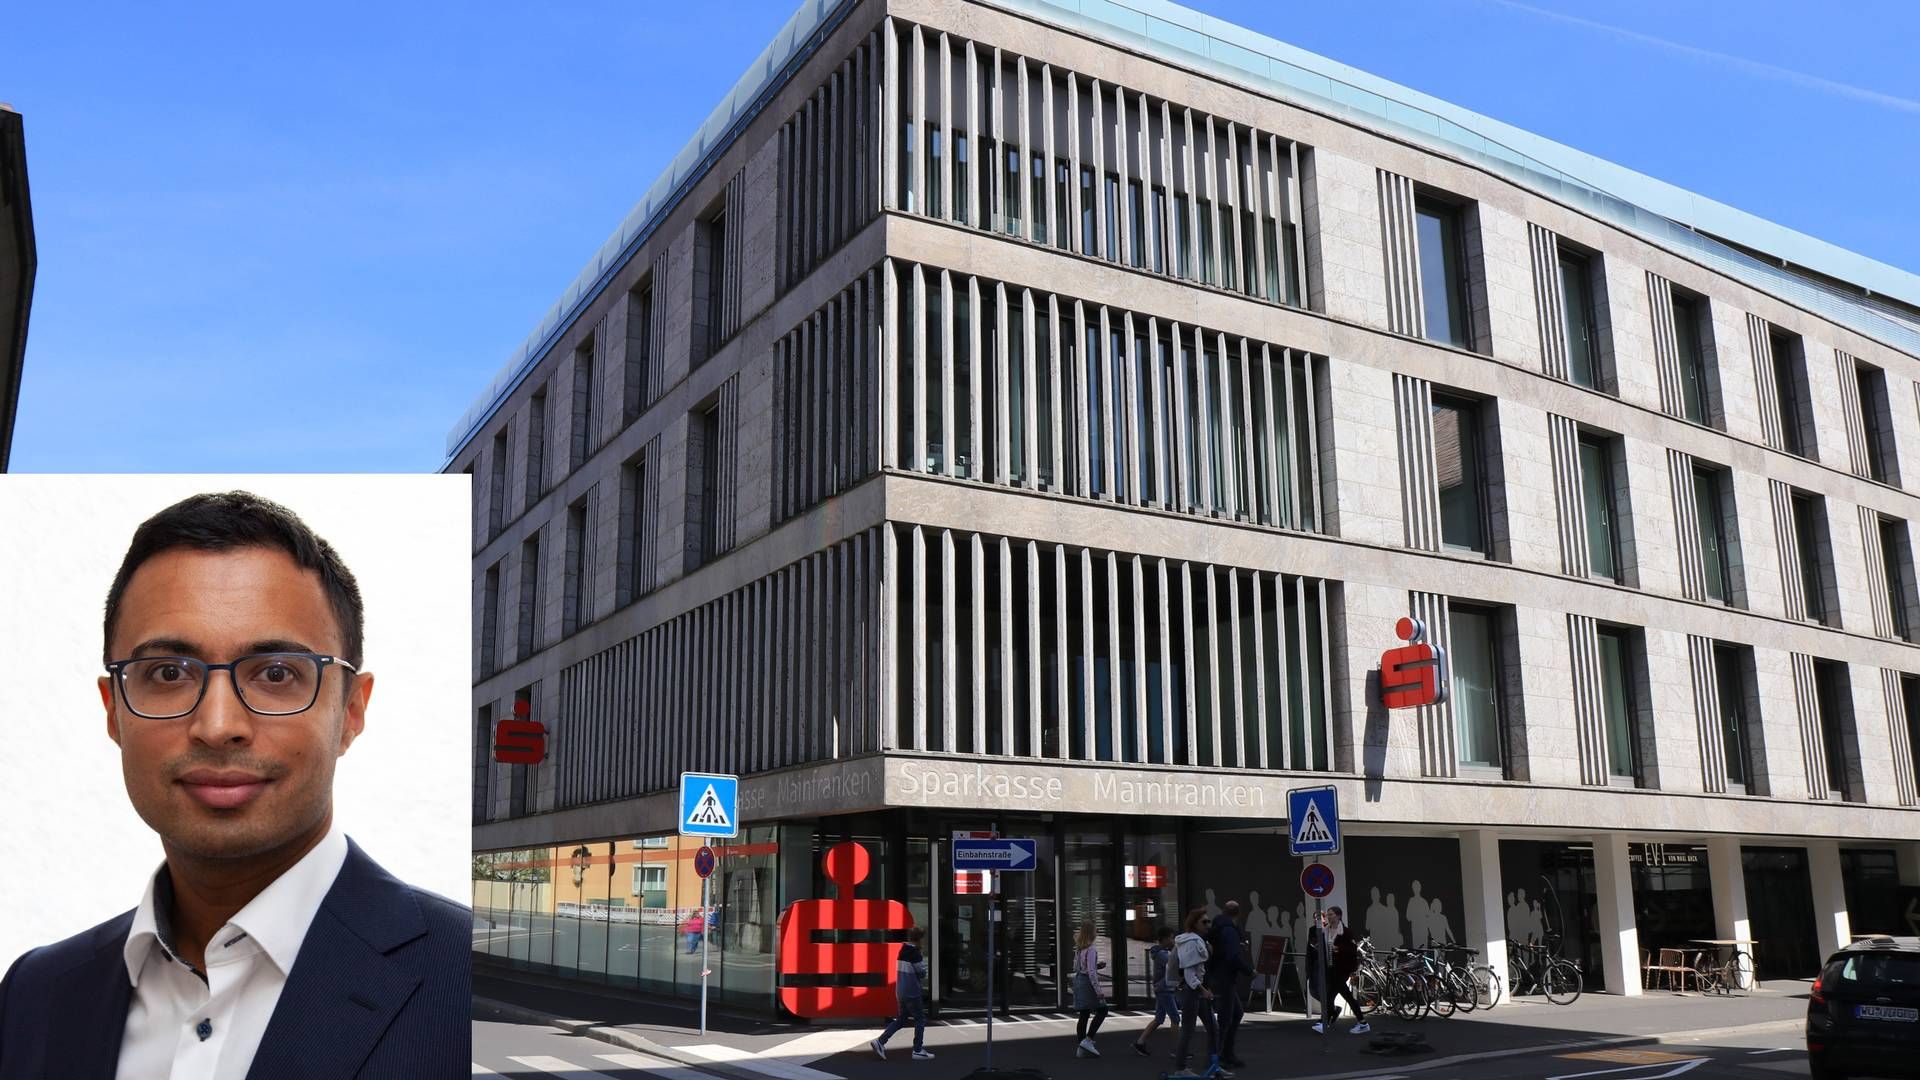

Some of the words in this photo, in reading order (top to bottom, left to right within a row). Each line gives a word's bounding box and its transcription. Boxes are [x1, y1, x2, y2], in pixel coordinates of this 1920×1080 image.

[777, 761, 870, 804] Mainfranken
[899, 762, 1062, 803] Sparkasse
[1093, 772, 1264, 808] Mainfranken
[957, 850, 1012, 859] Einbahnstraße
